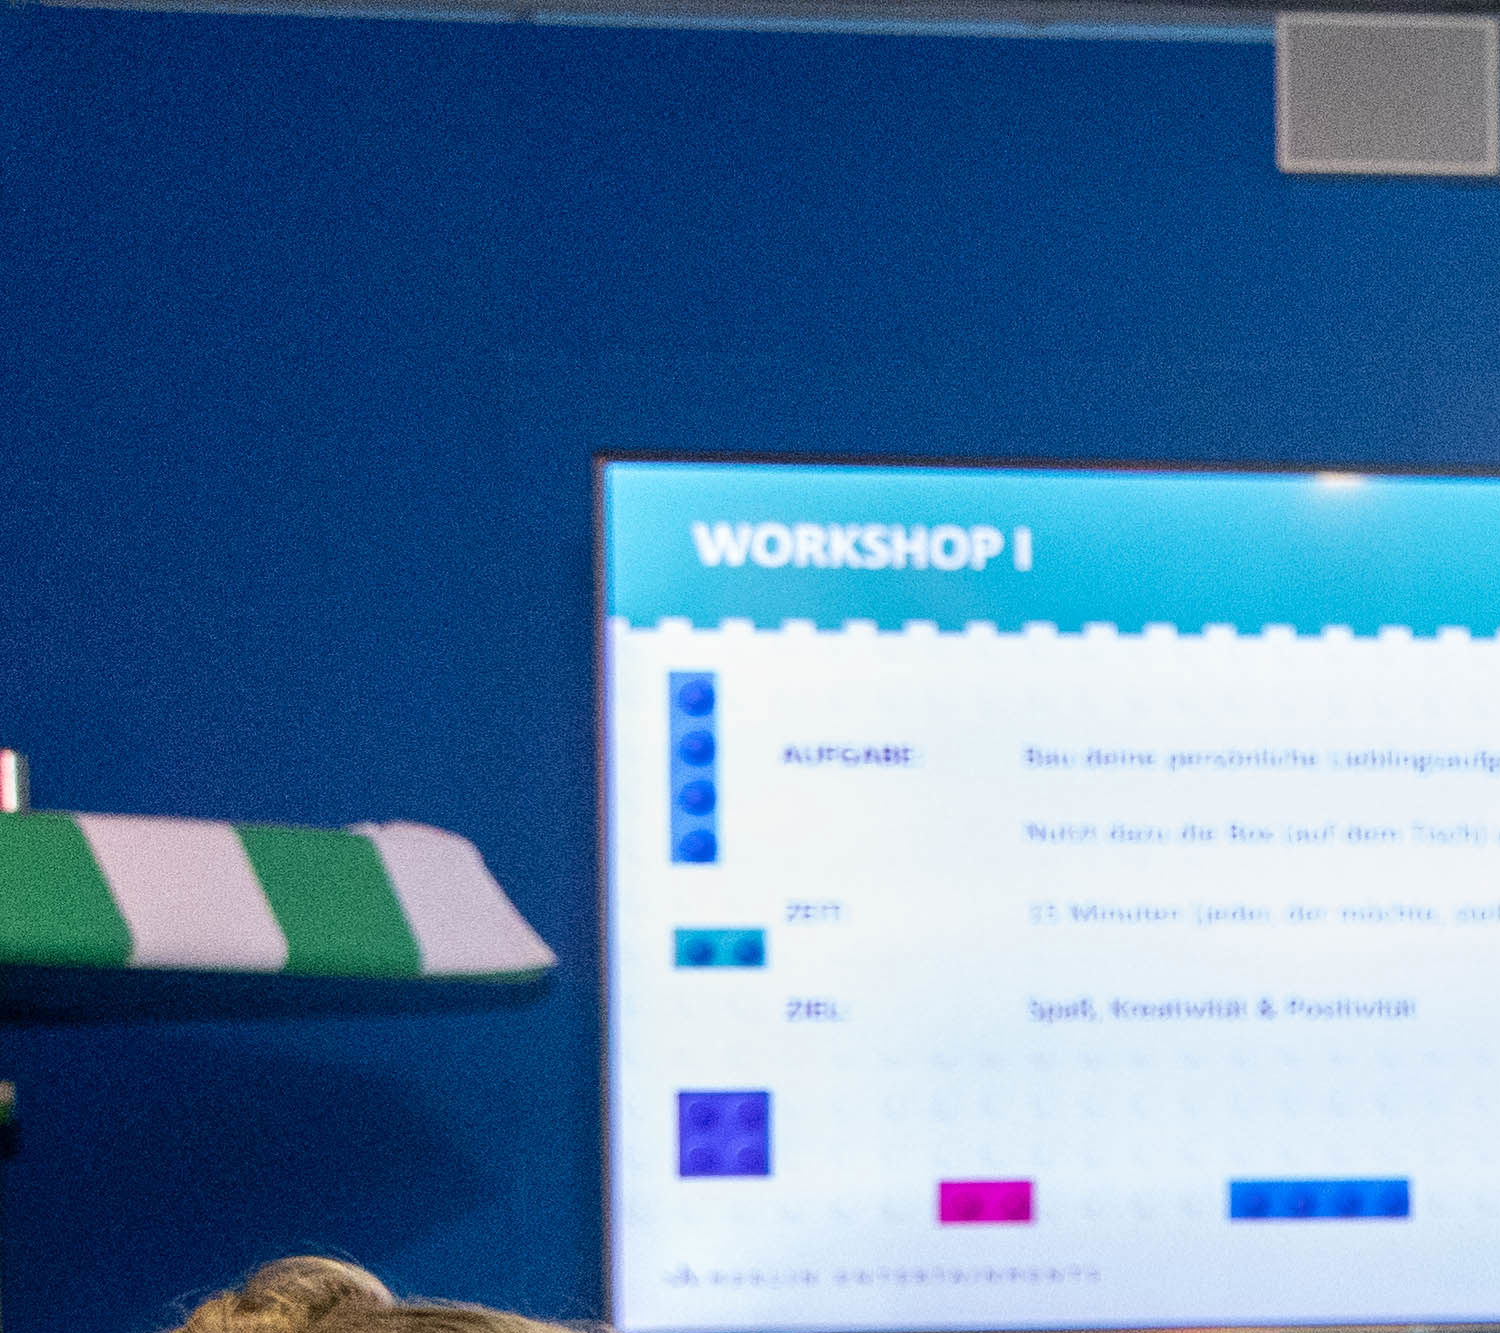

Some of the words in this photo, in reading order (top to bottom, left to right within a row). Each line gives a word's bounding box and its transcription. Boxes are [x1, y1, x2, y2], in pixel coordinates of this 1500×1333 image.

[692, 521, 1005, 571] WORKSHOP
[1013, 525, 1033, 572] I
[1257, 997, 1278, 1020] &
